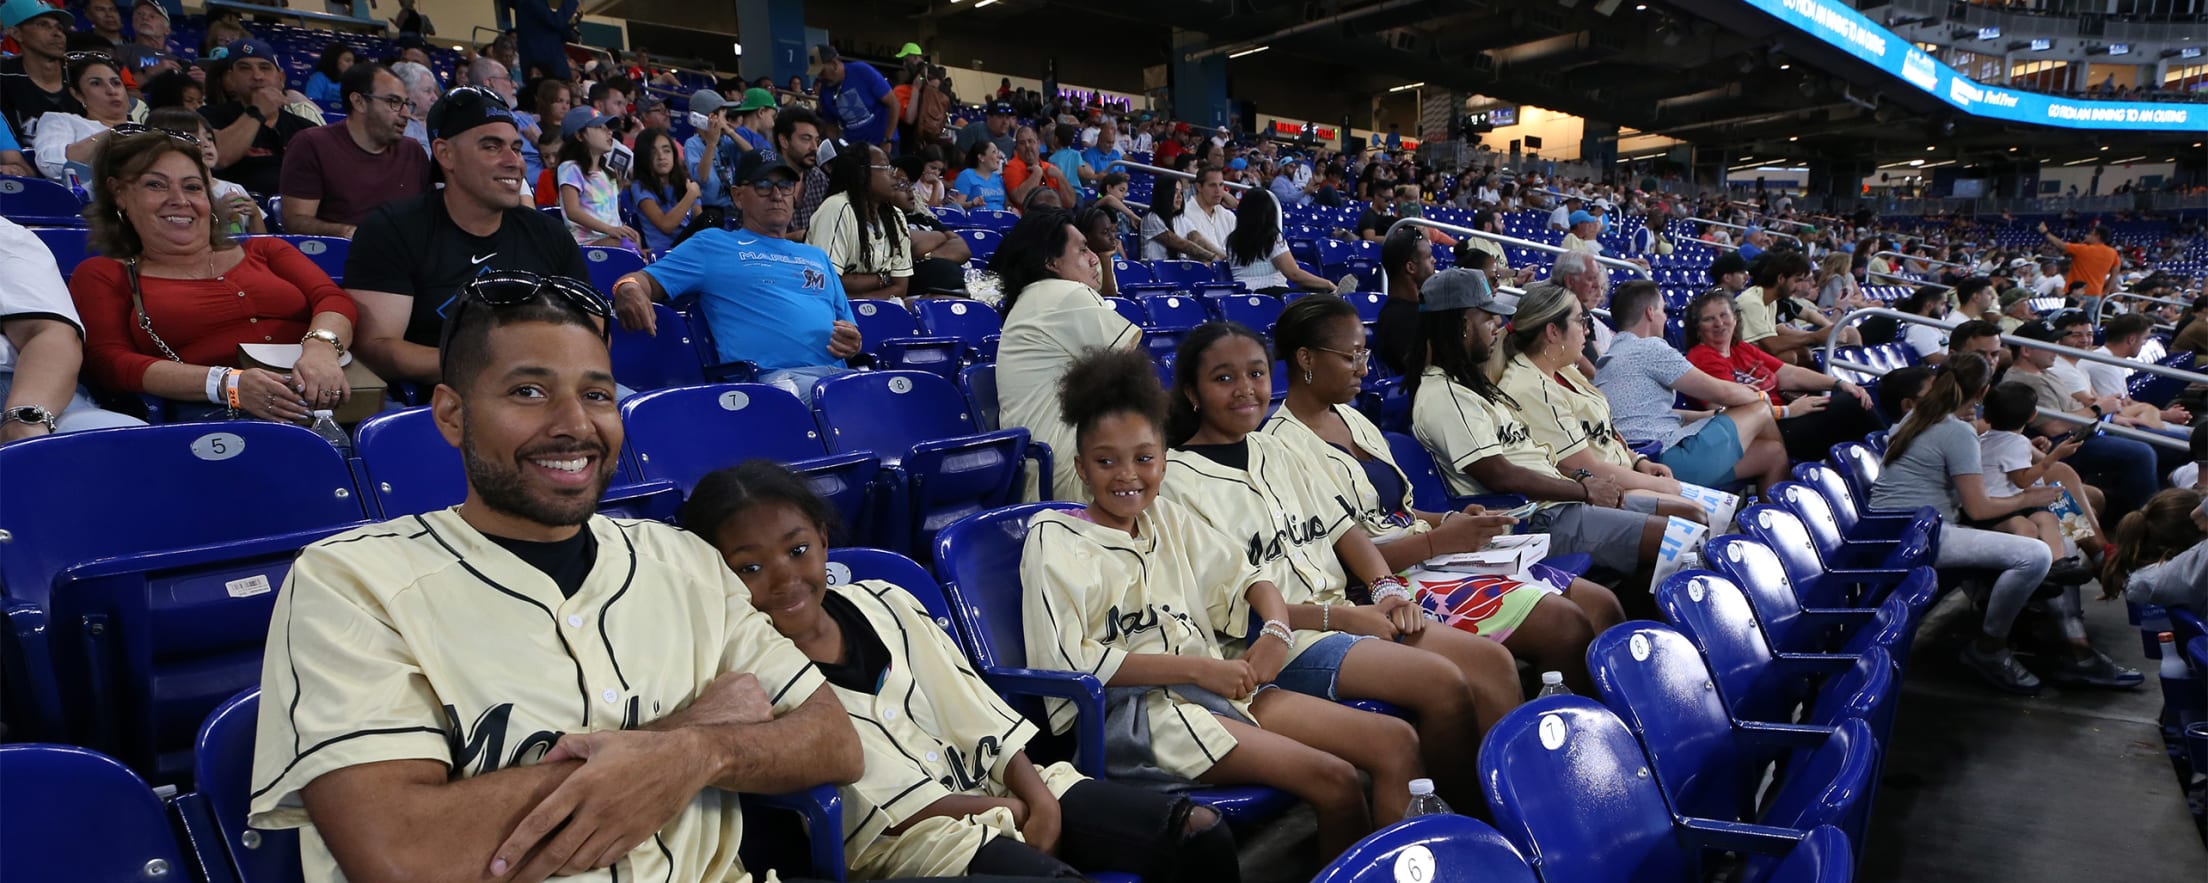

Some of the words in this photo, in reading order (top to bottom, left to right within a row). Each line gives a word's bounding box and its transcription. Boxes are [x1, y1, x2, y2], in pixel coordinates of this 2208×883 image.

[2048, 104, 2059, 118] GO
[2126, 108, 2138, 122] TO
[2138, 109, 2154, 122] AN
[728, 394, 737, 407] 7
[211, 437, 226, 455] 5
[825, 568, 837, 586] 6
[1545, 722, 1556, 742] 7
[1407, 857, 1422, 882] 6
